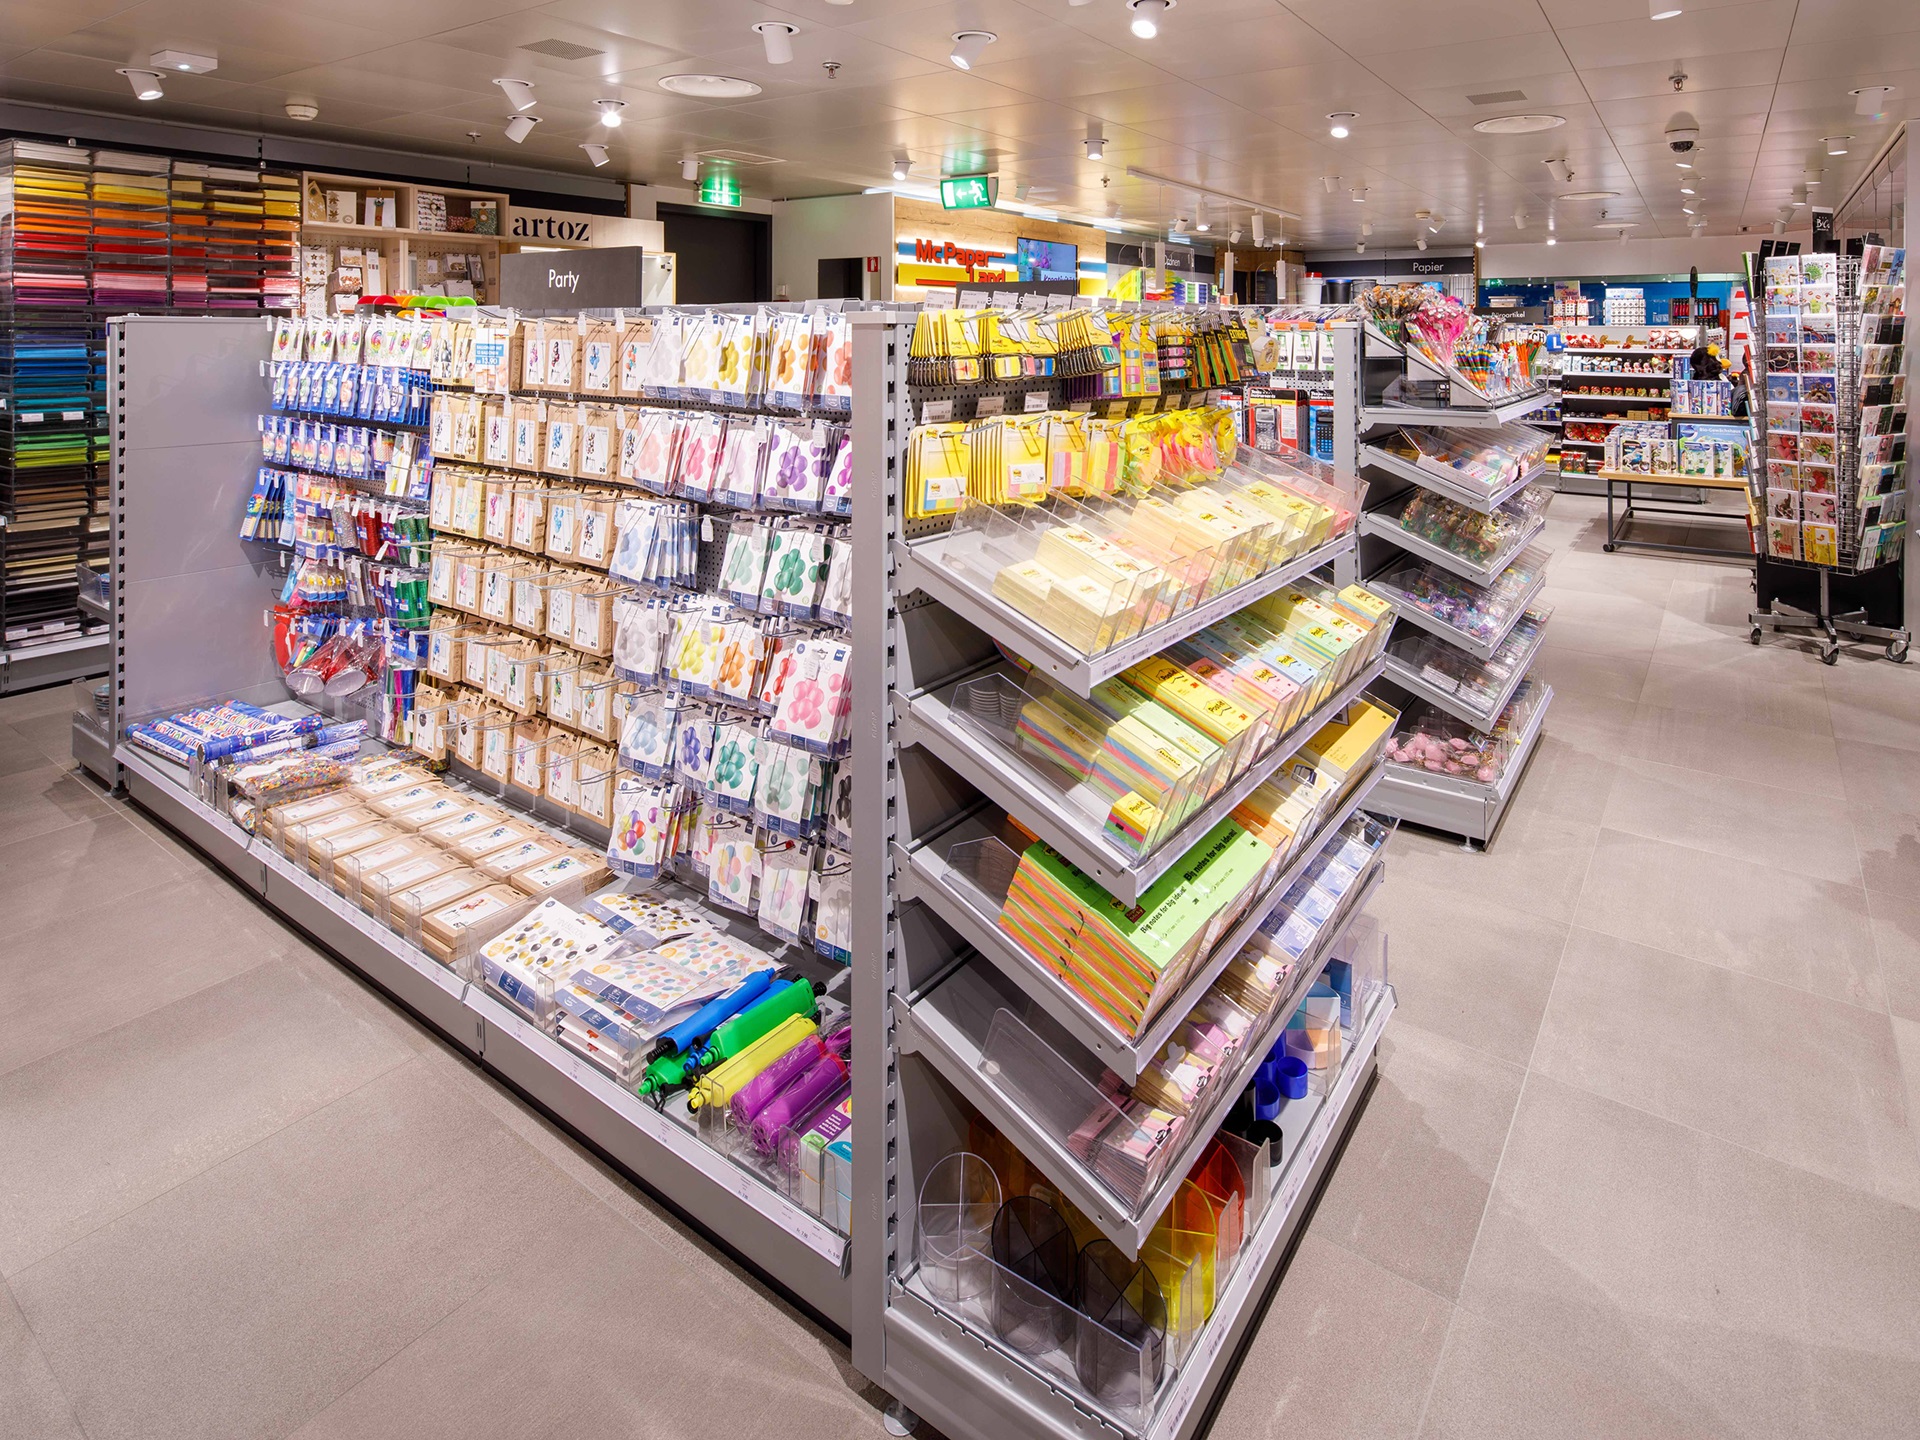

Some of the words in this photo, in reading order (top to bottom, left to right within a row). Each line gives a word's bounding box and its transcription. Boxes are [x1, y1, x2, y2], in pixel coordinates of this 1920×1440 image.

[513, 217, 590, 241] artoz
[1412, 262, 1444, 274] Papier
[548, 269, 580, 293] Party
[1552, 336, 1562, 349] L
[1183, 870, 1198, 882] Big
[1193, 857, 1210, 873] notes
[1205, 849, 1217, 859] for
[1213, 841, 1227, 852] big
[1140, 921, 1152, 934] Big
[1149, 911, 1161, 925] notes
[1159, 904, 1168, 913] for
[1165, 897, 1177, 910] big
